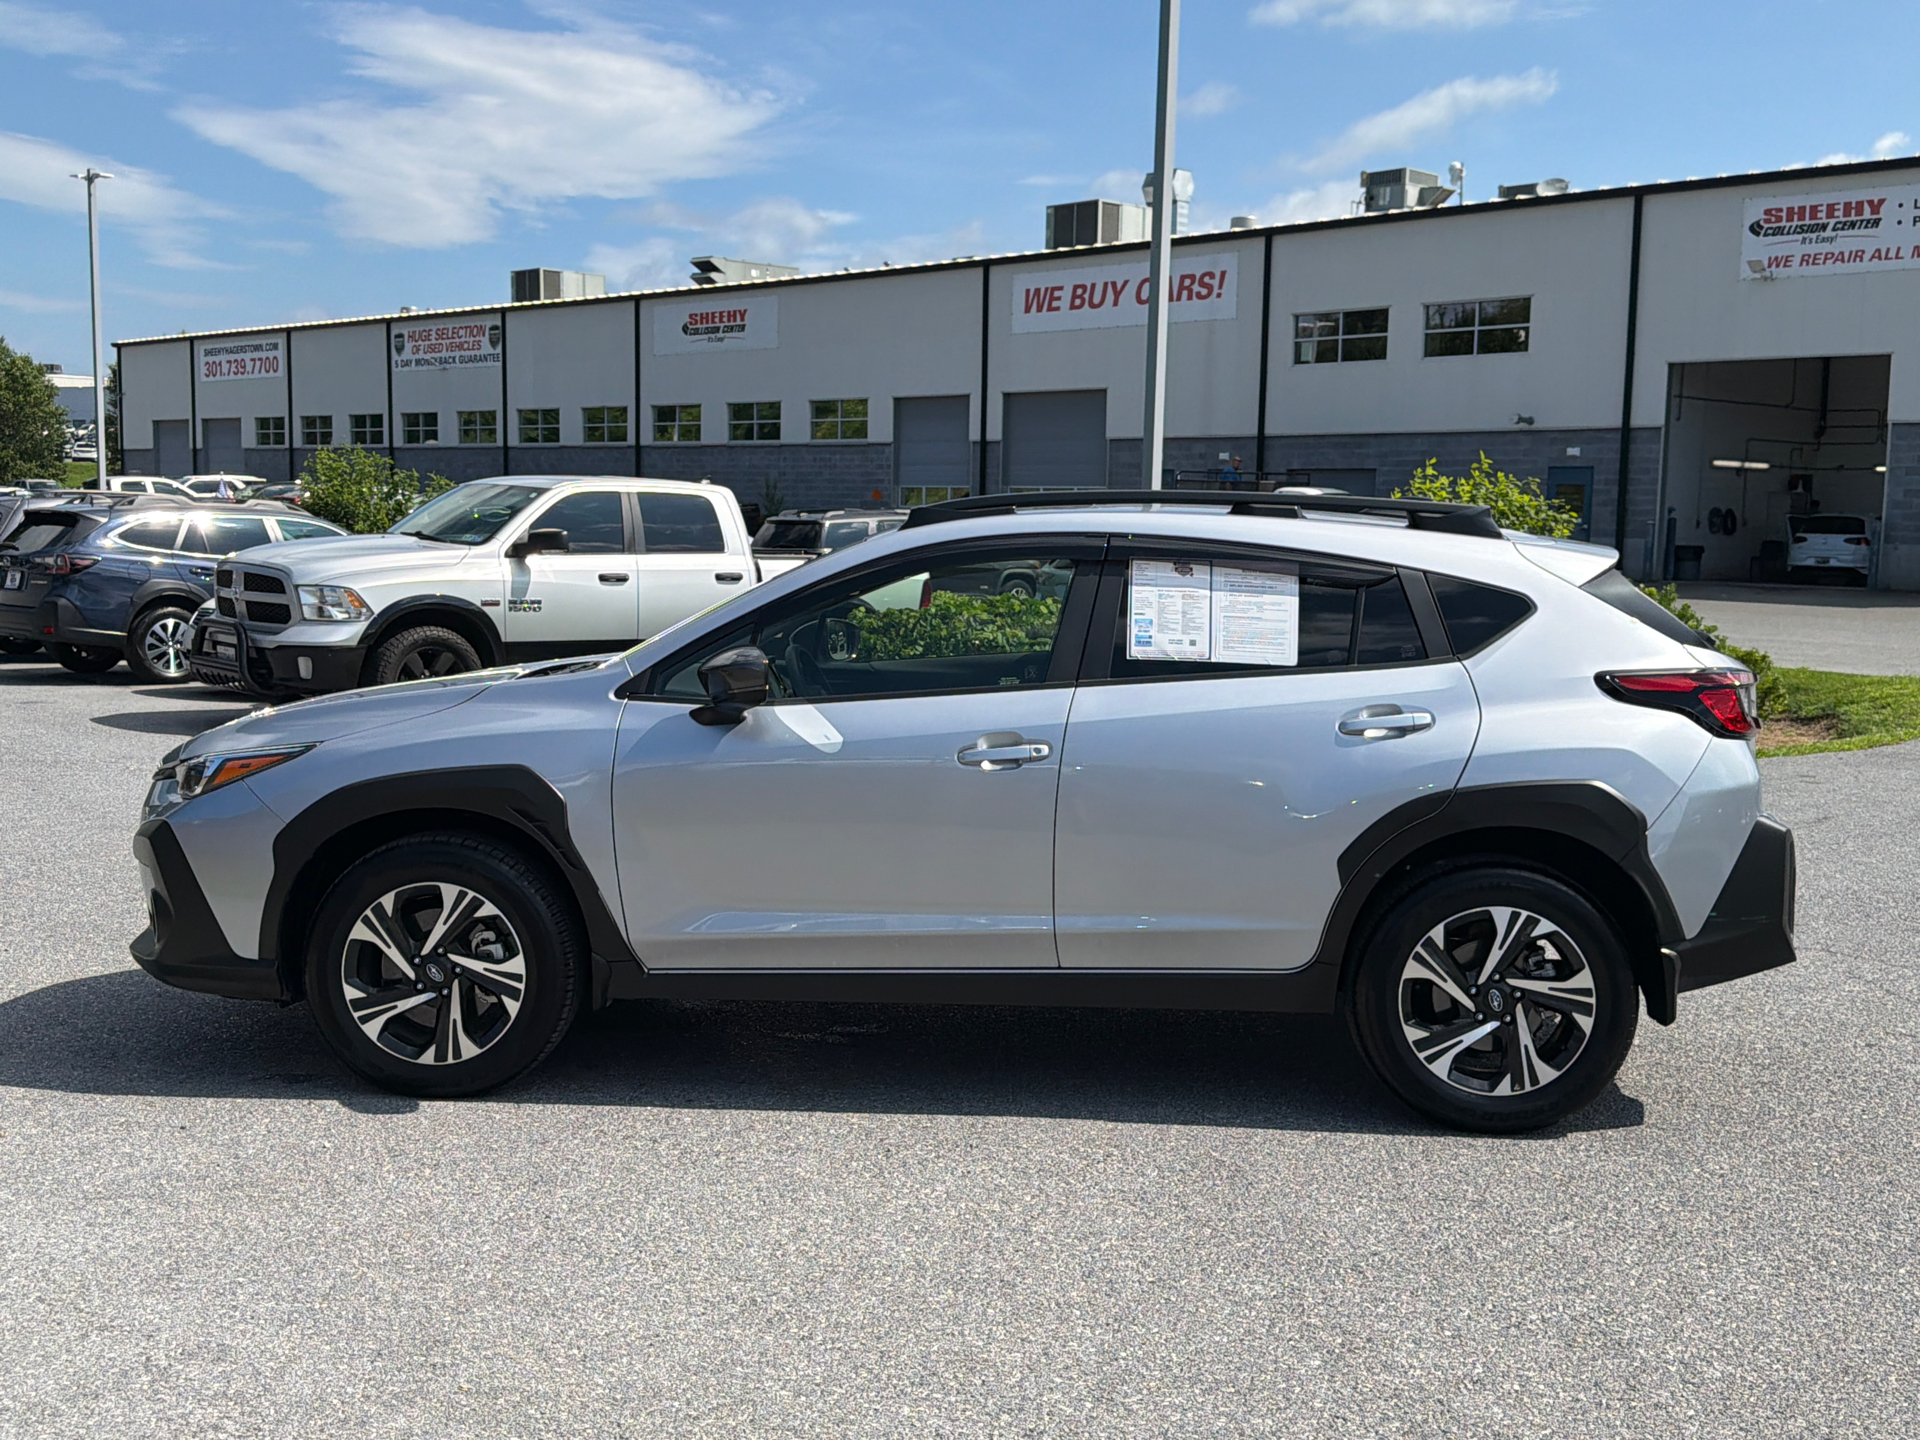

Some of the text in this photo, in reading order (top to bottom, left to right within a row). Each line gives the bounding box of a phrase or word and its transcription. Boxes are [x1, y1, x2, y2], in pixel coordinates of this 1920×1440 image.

[1763, 198, 1887, 225] SHEEHY
[1762, 217, 1883, 237] COLLISION CENTER
[1800, 233, 1838, 245] It's Easy!
[1767, 254, 1795, 269] WE
[1798, 249, 1866, 267] REPAIR
[1868, 246, 1905, 262] ALL
[1024, 270, 1228, 314] WE BUY CRS!
[688, 308, 748, 326] SHEEHY
[407, 328, 433, 343] HUGE
[435, 324, 487, 341] SELECTION
[688, 324, 747, 336] COLLISION CENTER
[204, 342, 279, 357] SHEEHYHAGERSTOWN.COM
[411, 343, 422, 355] OF
[423, 342, 444, 354] USED
[445, 340, 482, 353] VEHICLES
[204, 355, 279, 378] 301.739.7700
[395, 360, 399, 369] 5
[400, 358, 413, 368] DAY
[459, 353, 501, 365] GUARANTEE
[508, 598, 542, 606] RAM
[508, 604, 542, 613] 1500
